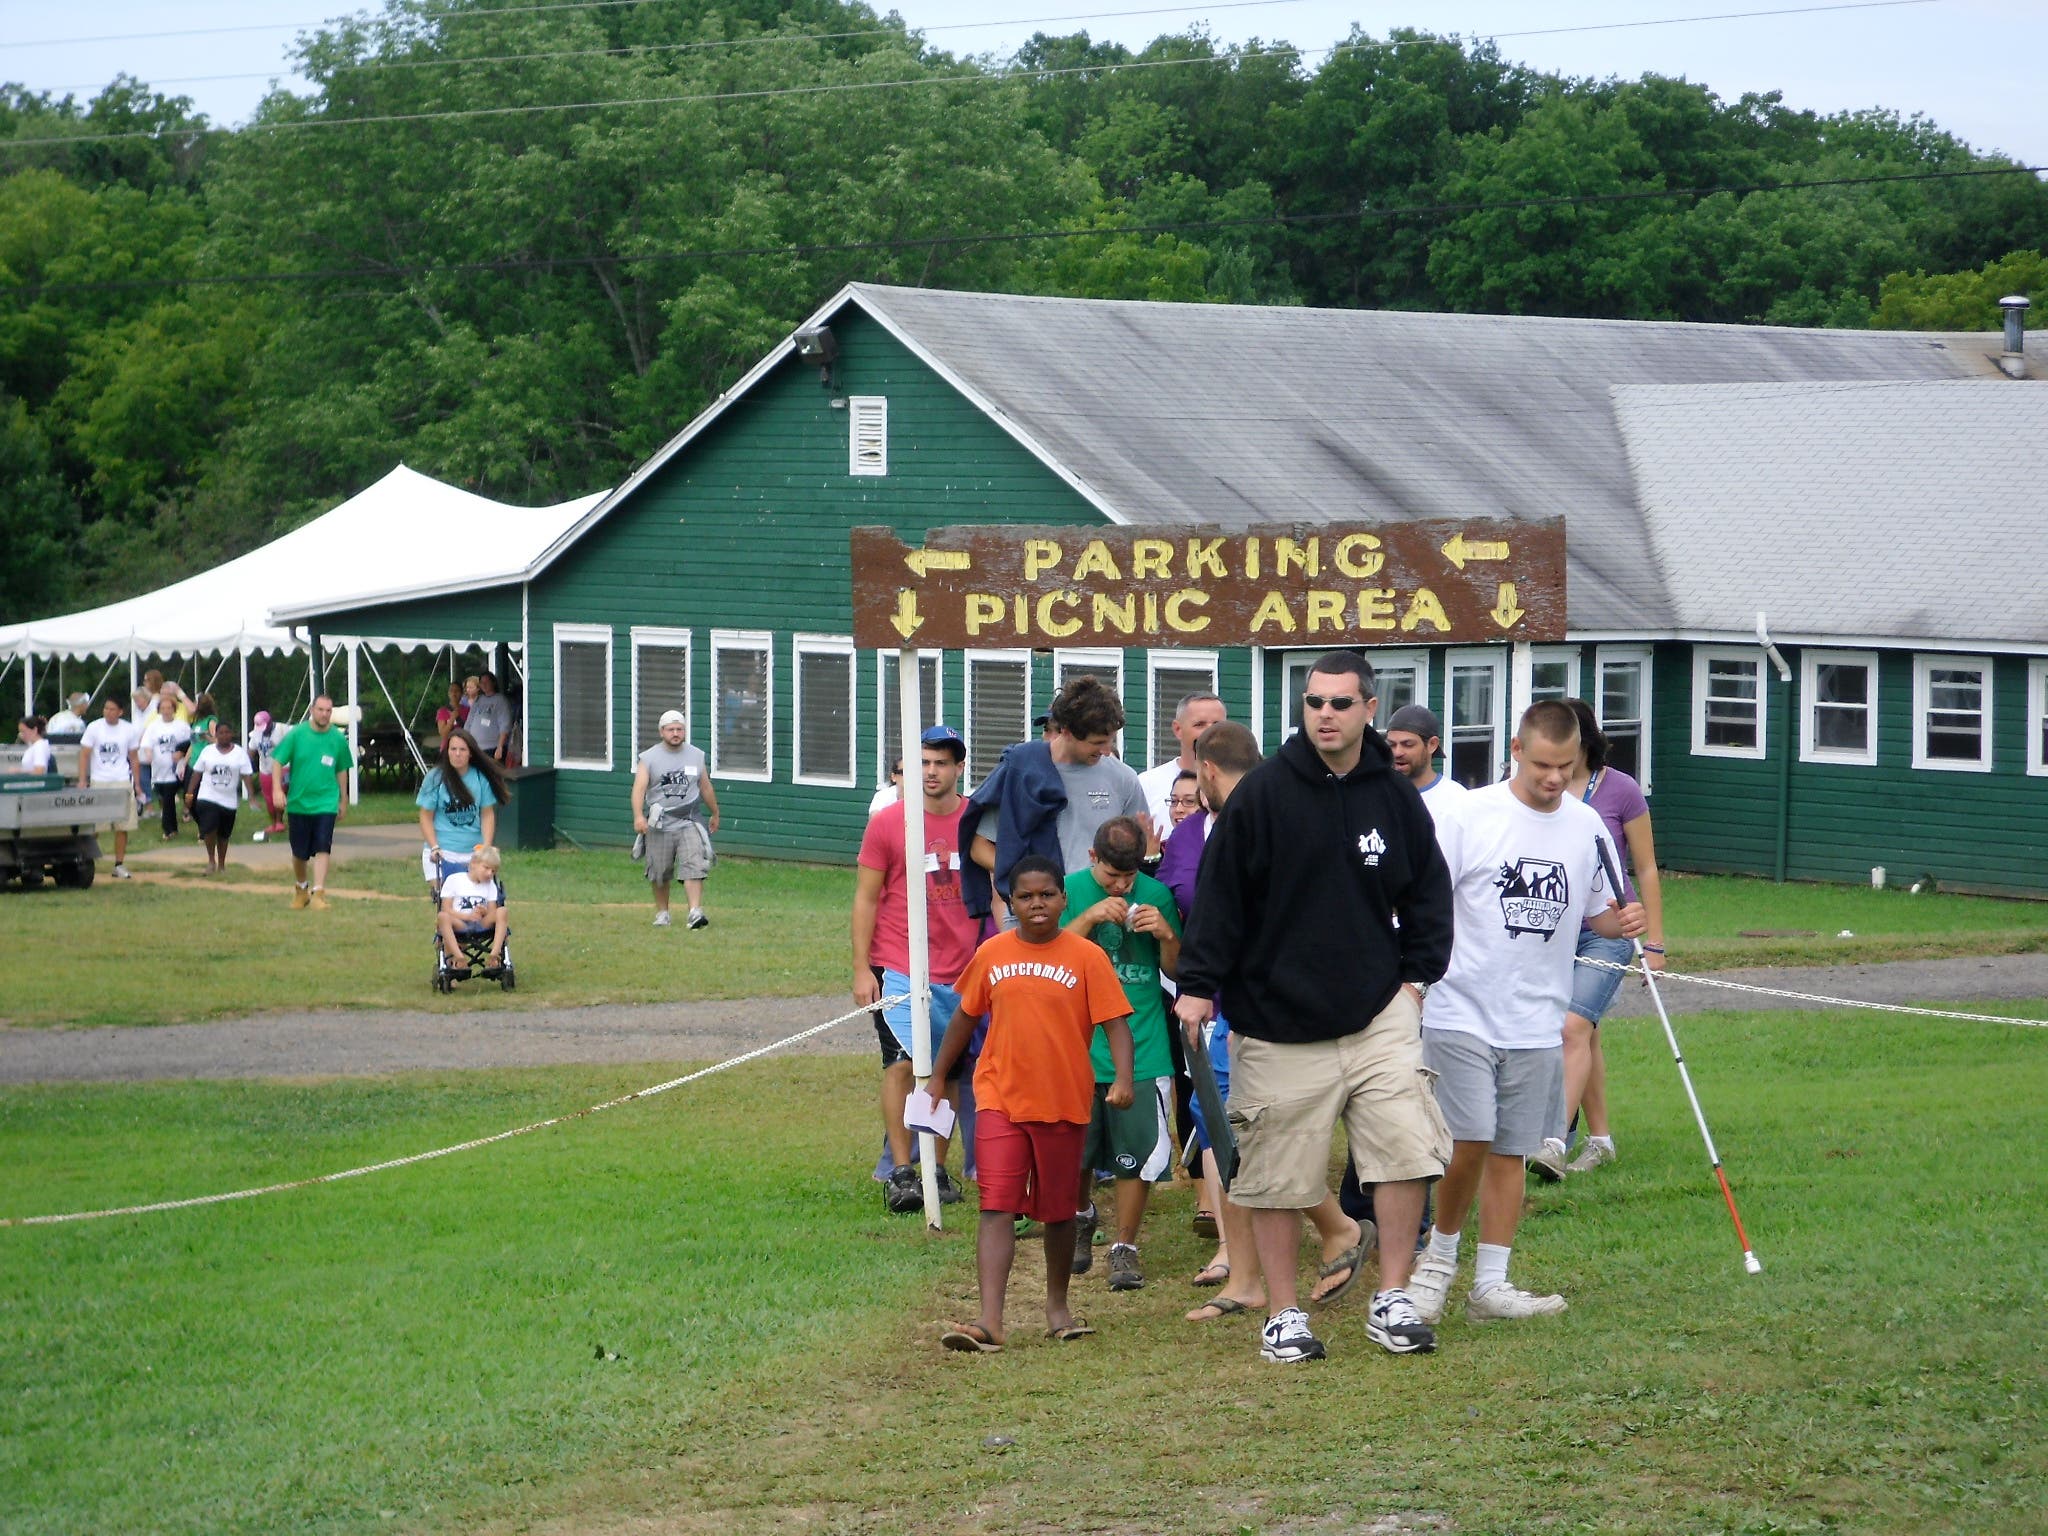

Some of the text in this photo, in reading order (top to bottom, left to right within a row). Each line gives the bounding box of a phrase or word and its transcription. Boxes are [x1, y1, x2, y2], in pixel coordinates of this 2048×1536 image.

[1023, 533, 1386, 581] PARKING
[964, 587, 1452, 638] PICNIC AREA
[54, 795, 94, 808] Club Car
[988, 961, 1078, 989] abercrombie
